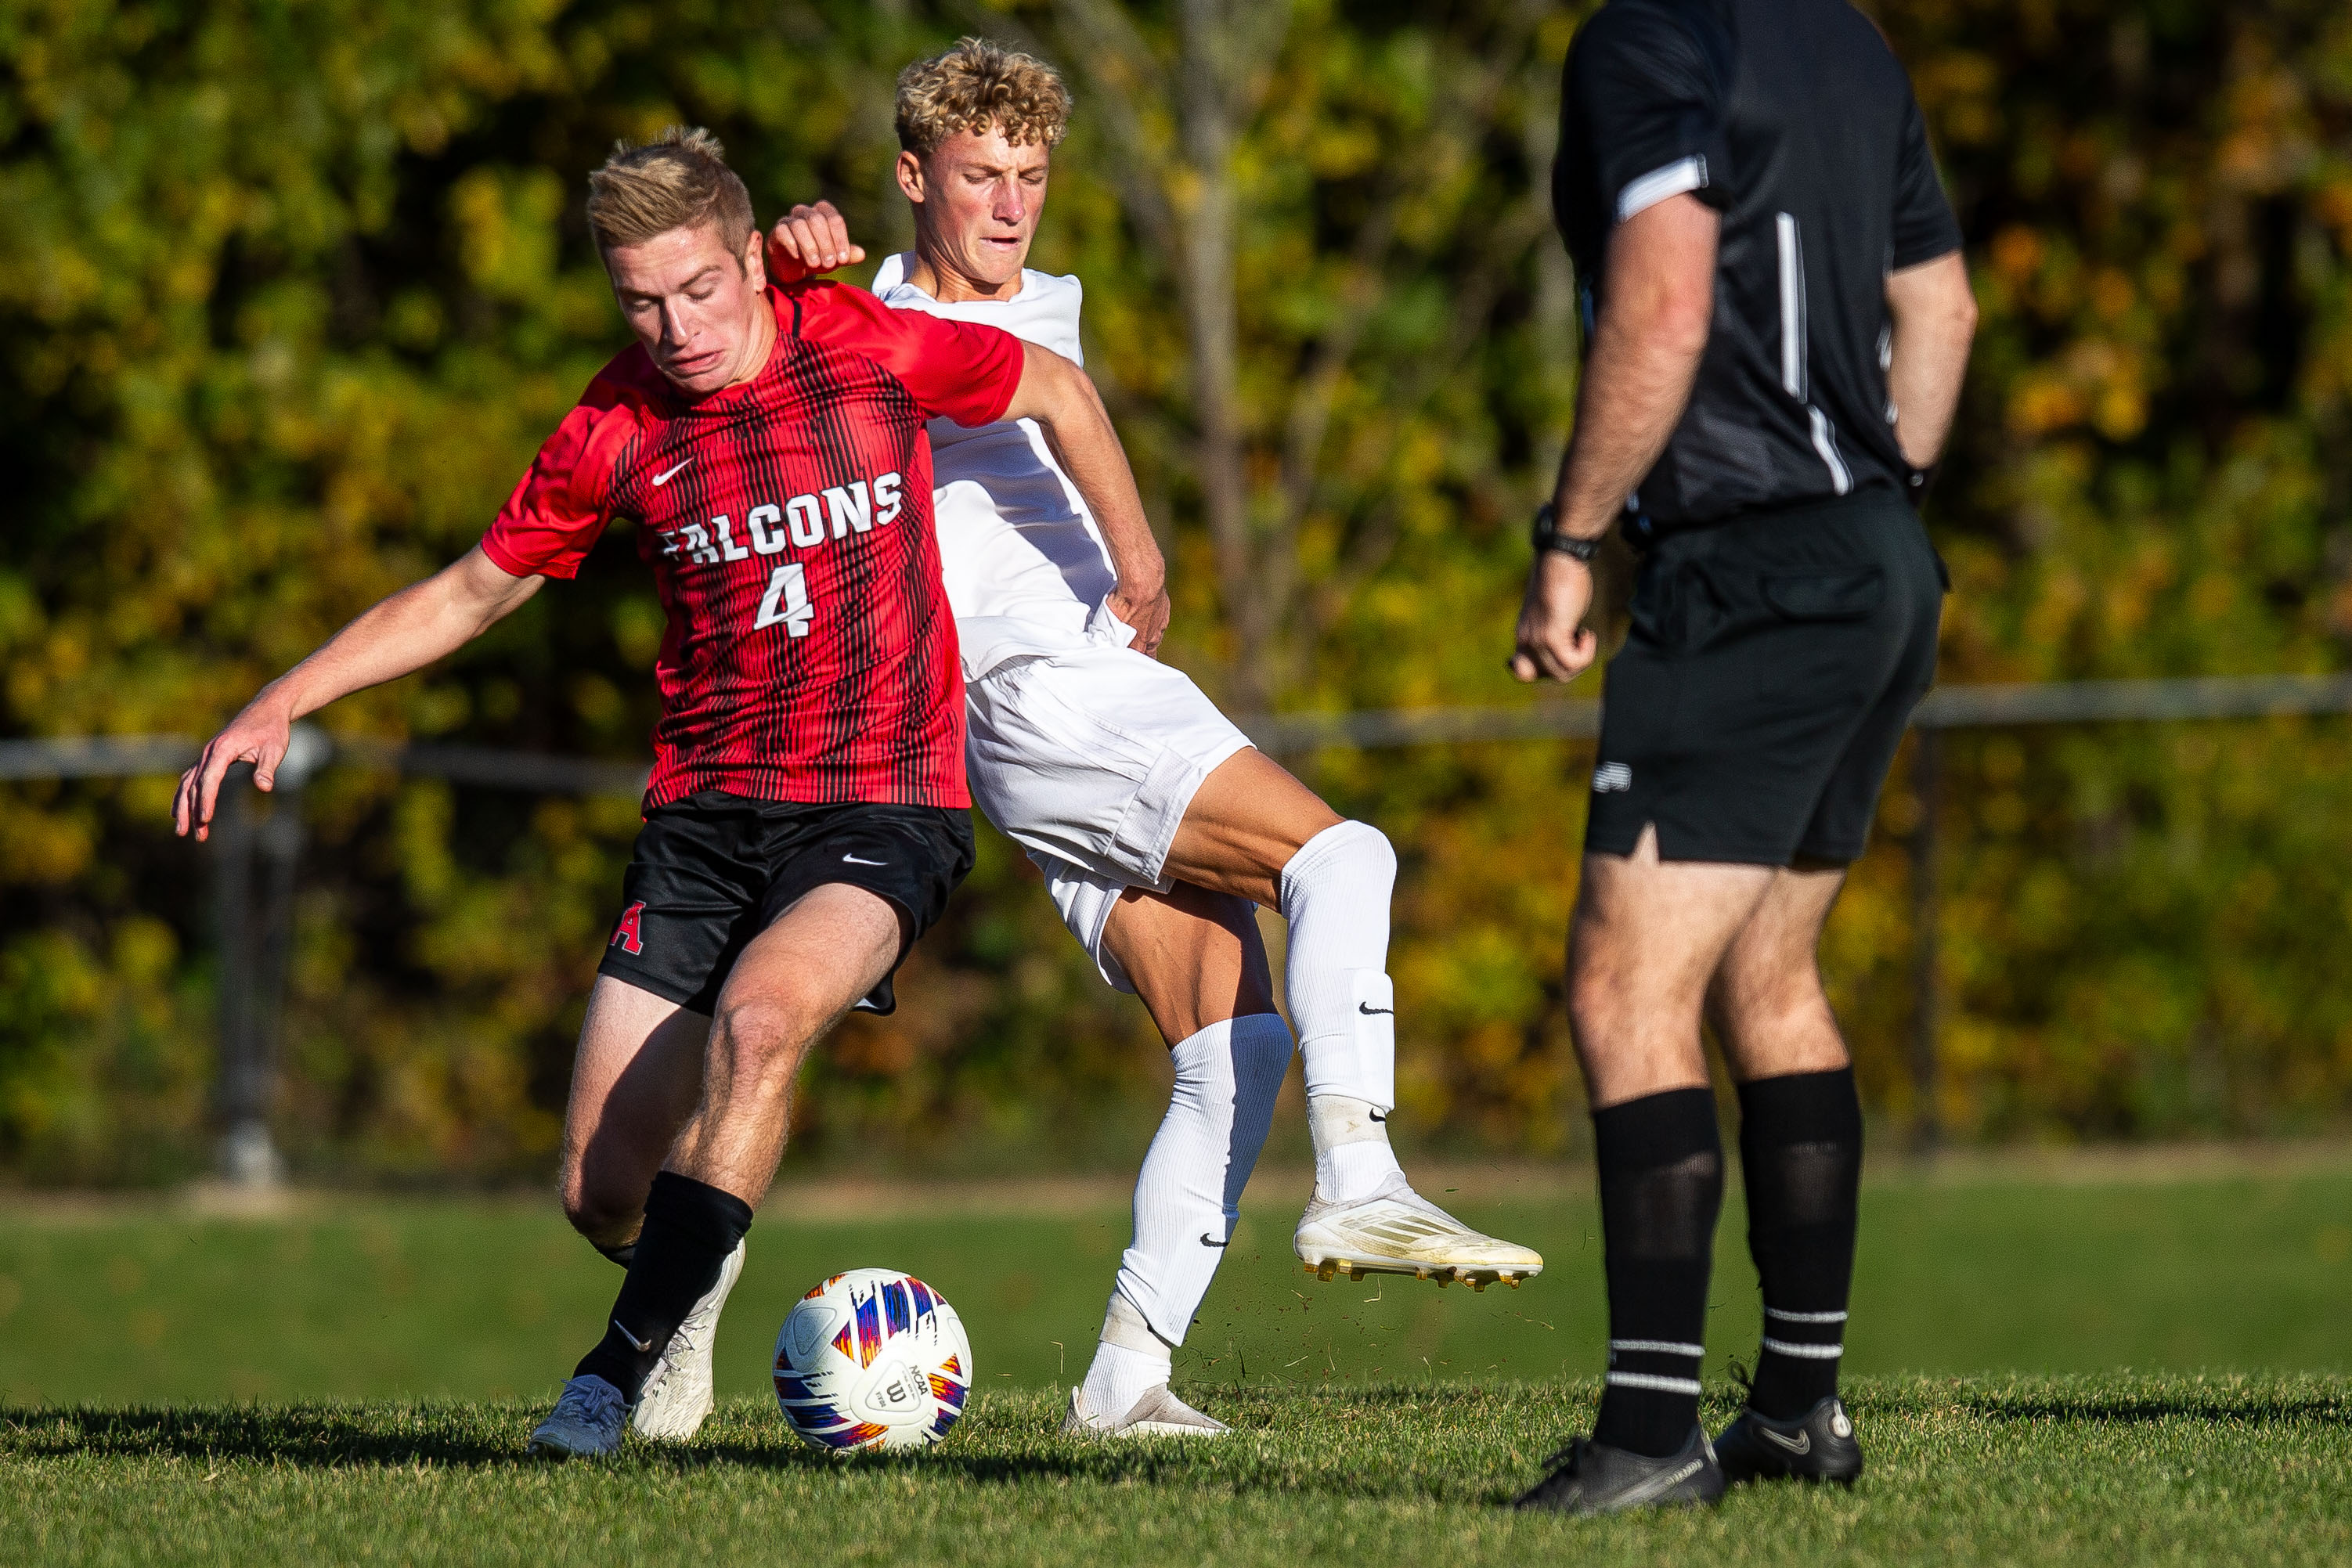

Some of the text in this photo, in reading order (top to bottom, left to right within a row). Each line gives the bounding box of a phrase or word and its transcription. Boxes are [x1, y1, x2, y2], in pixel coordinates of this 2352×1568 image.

[753, 563, 813, 638] 4
[611, 900, 646, 955] A
[909, 1364, 929, 1396] NCAA
